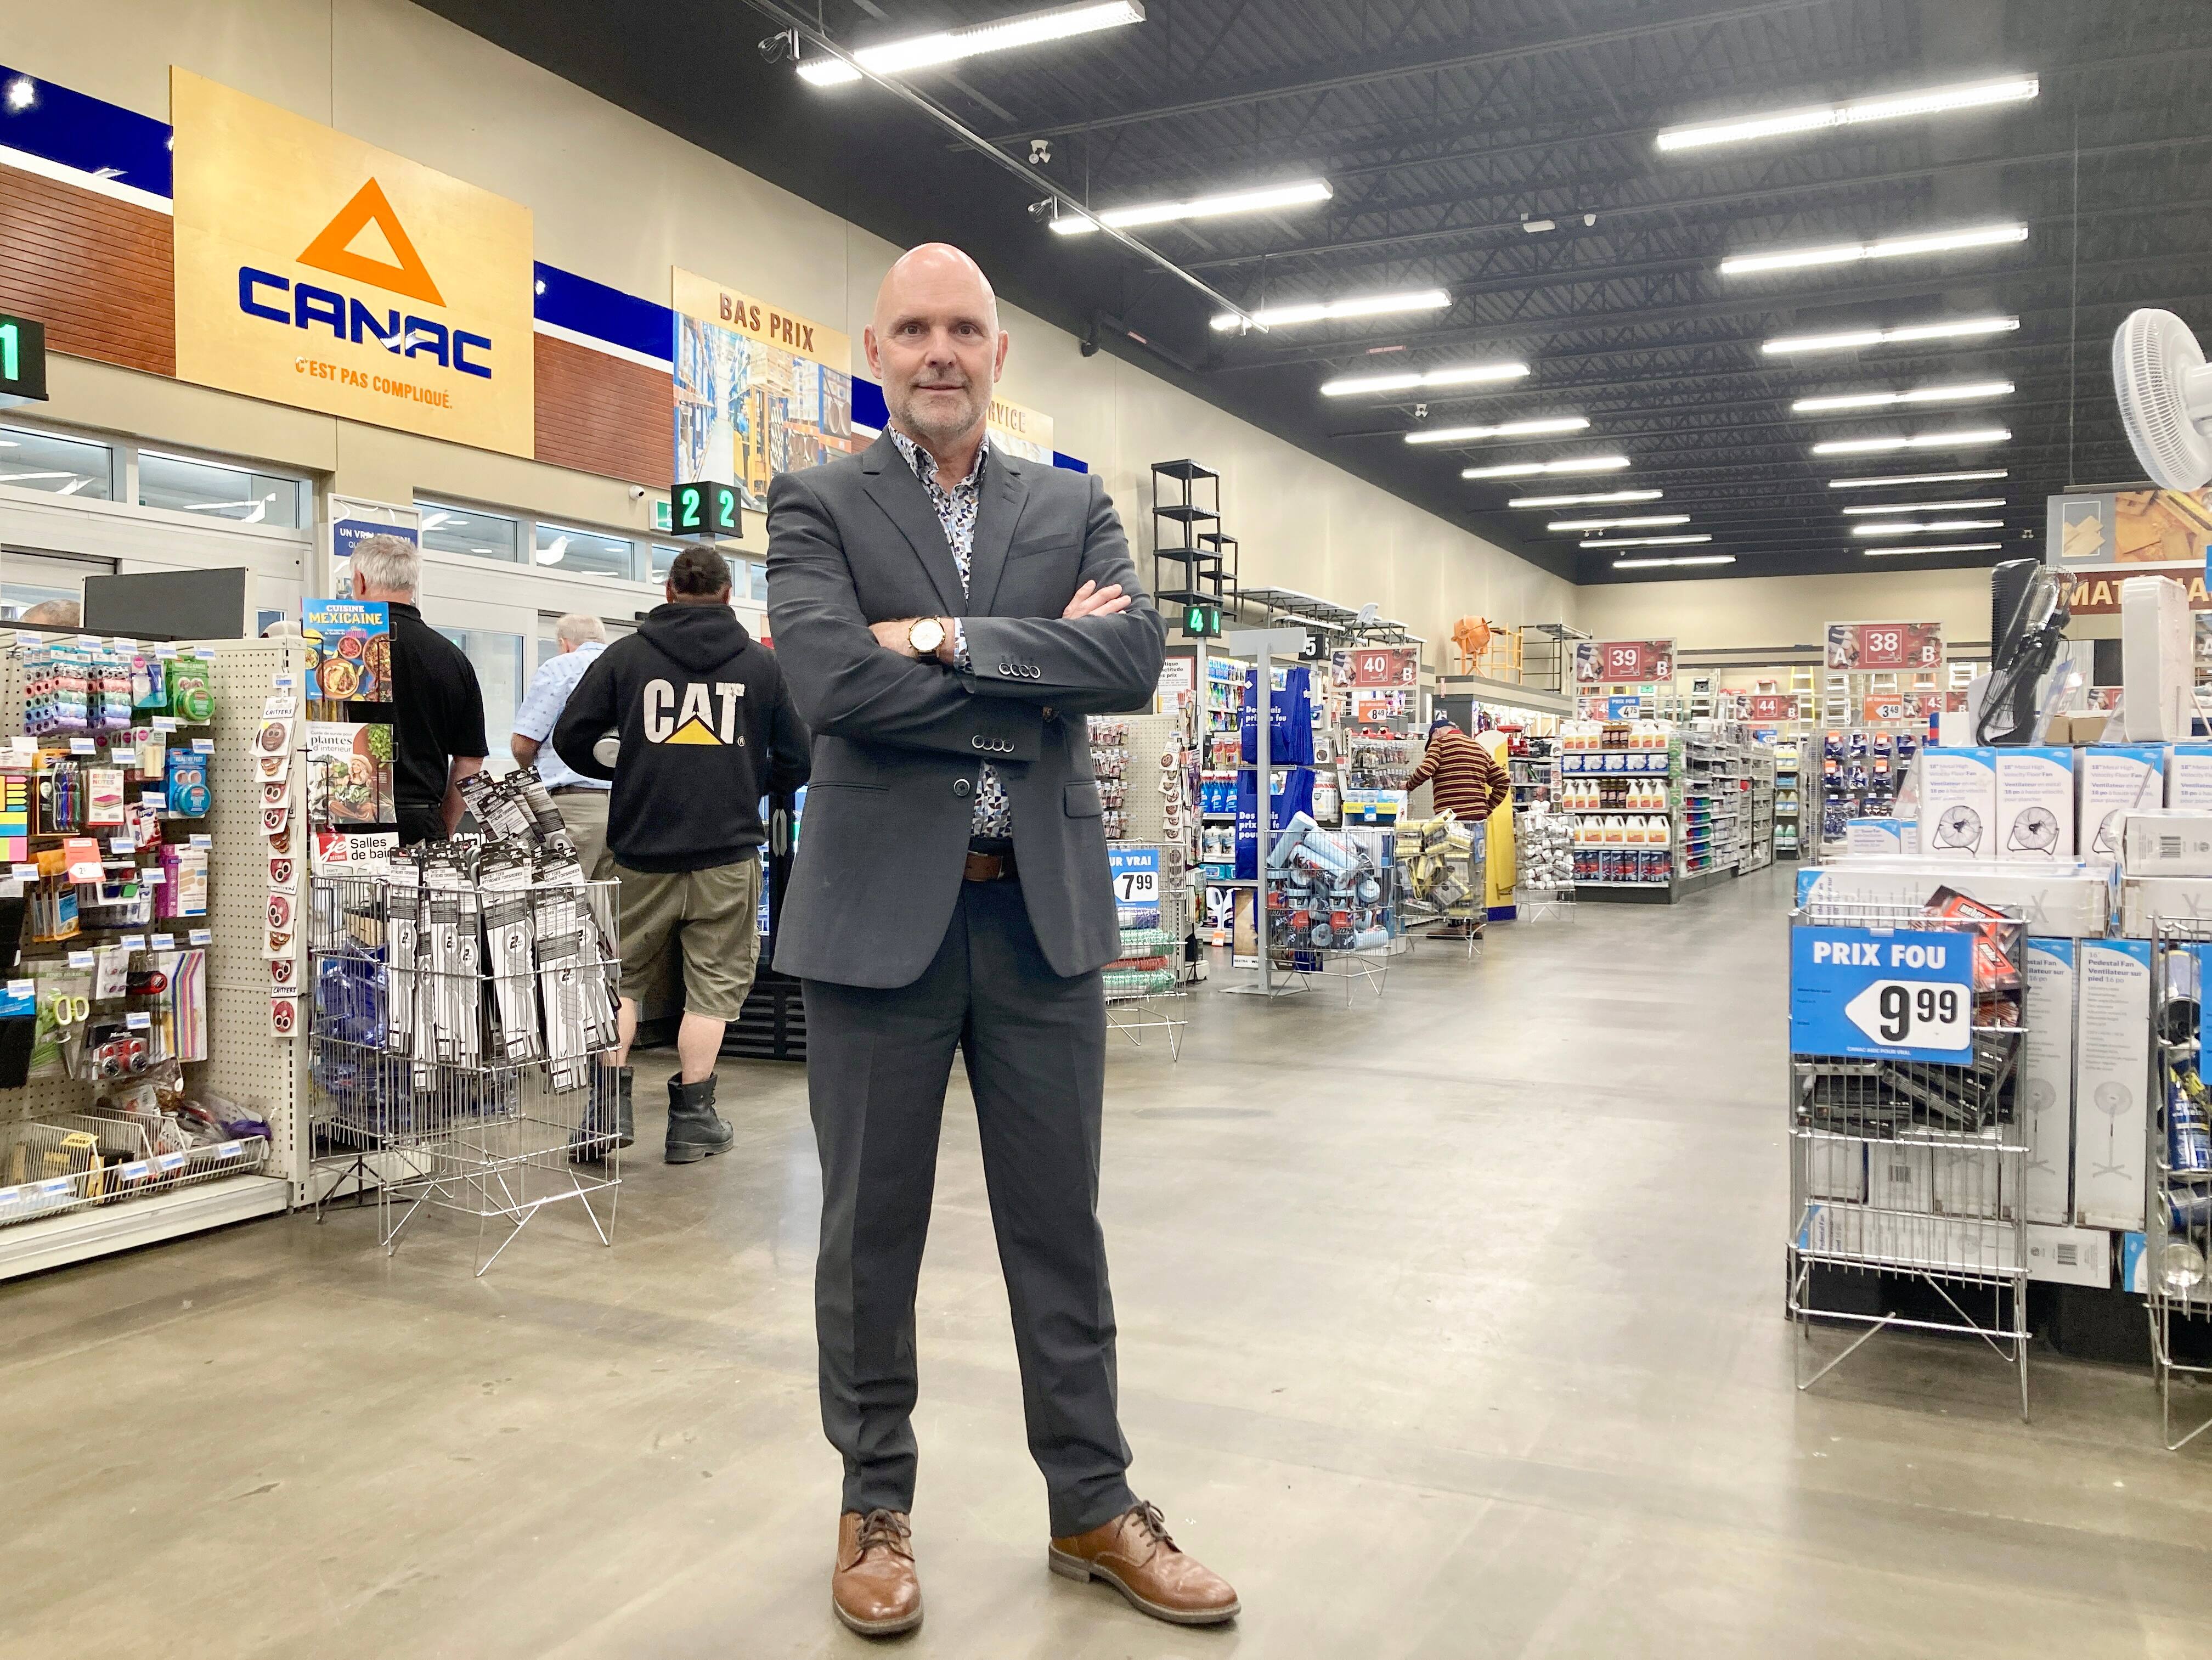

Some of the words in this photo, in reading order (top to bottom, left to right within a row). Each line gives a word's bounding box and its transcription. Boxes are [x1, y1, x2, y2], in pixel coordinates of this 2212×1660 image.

[239, 266, 492, 380] CANAC
[720, 292, 760, 331] BAS
[770, 312, 814, 352] PRIX
[0, 324, 18, 380] 1
[295, 356, 336, 380] C'EST
[341, 368, 368, 389] PAS
[374, 376, 453, 409] COMPLIQUÉ.
[682, 489, 700, 526] 2
[719, 491, 735, 527] 2
[340, 528, 352, 537] UN
[309, 612, 383, 625] MEXICAINE
[1190, 609, 1203, 632] 4
[1213, 611, 1219, 633] 4
[1306, 637, 1316, 656] 5
[1324, 637, 1330, 656] 5
[1870, 633, 1898, 651] 38
[1612, 650, 1637, 666] 39
[1833, 648, 1848, 664] A
[1922, 646, 1935, 662] B
[1364, 657, 1385, 672] 40
[1582, 663, 1594, 678] A
[1657, 661, 1668, 676] B
[1337, 669, 1347, 683] A
[1403, 667, 1413, 681] B
[644, 679, 745, 744] CAT
[1599, 703, 1609, 713] 4
[1624, 707, 1629, 717] 4
[1759, 700, 1775, 711] 44
[1788, 707, 1795, 717] B
[1882, 706, 1889, 717] 3
[1907, 706, 1915, 716] A
[1246, 714, 1257, 723] pri
[1372, 710, 1377, 719] 8
[1580, 711, 1588, 719] A
[1740, 708, 1748, 718] A
[311, 736, 352, 746] plantes
[1239, 820, 1256, 831] prix
[321, 836, 346, 862] je
[351, 837, 387, 848] Salles
[352, 849, 365, 860] de
[1109, 857, 1123, 866] UR
[1126, 856, 1152, 866] VRAI
[1123, 875, 1134, 899] 7
[1137, 875, 1152, 890] 99
[1960, 904, 1986, 919] weber
[402, 933, 408, 943] 2
[447, 937, 452, 948] 2
[510, 936, 518, 949] 2
[463, 949, 469, 960] 2
[1814, 942, 1881, 966] PRIX
[1892, 944, 1946, 969] FOU
[562, 969, 571, 981] 2
[1880, 986, 1910, 1042] 9
[1917, 989, 1958, 1024] 99
